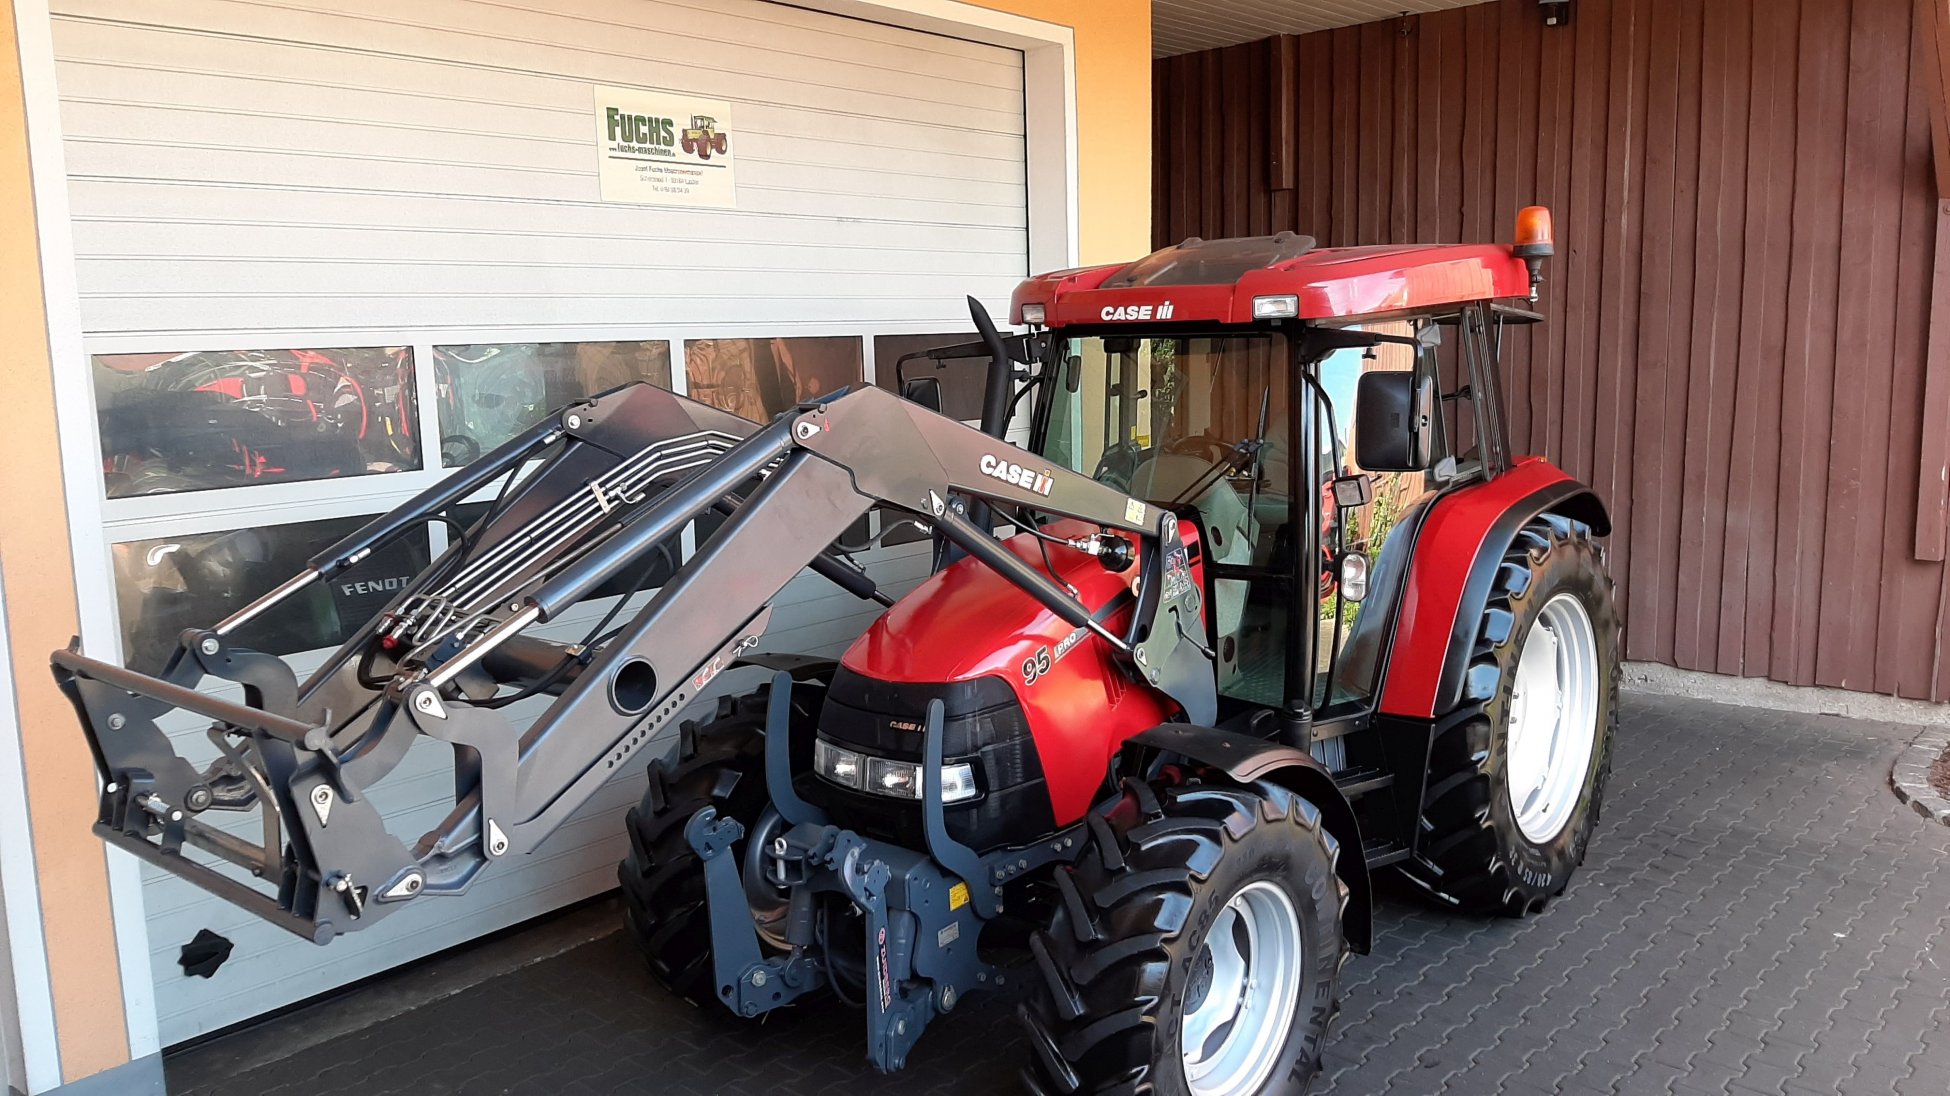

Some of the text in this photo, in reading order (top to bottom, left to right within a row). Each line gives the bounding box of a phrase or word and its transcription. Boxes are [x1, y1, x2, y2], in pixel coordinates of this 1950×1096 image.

[606, 106, 675, 147] FUCHS
[1100, 305, 1153, 321] CASE
[979, 454, 1036, 490] CASE
[340, 576, 410, 596] FENDT
[1022, 644, 1051, 686] 95
[889, 720, 916, 731] CASE
